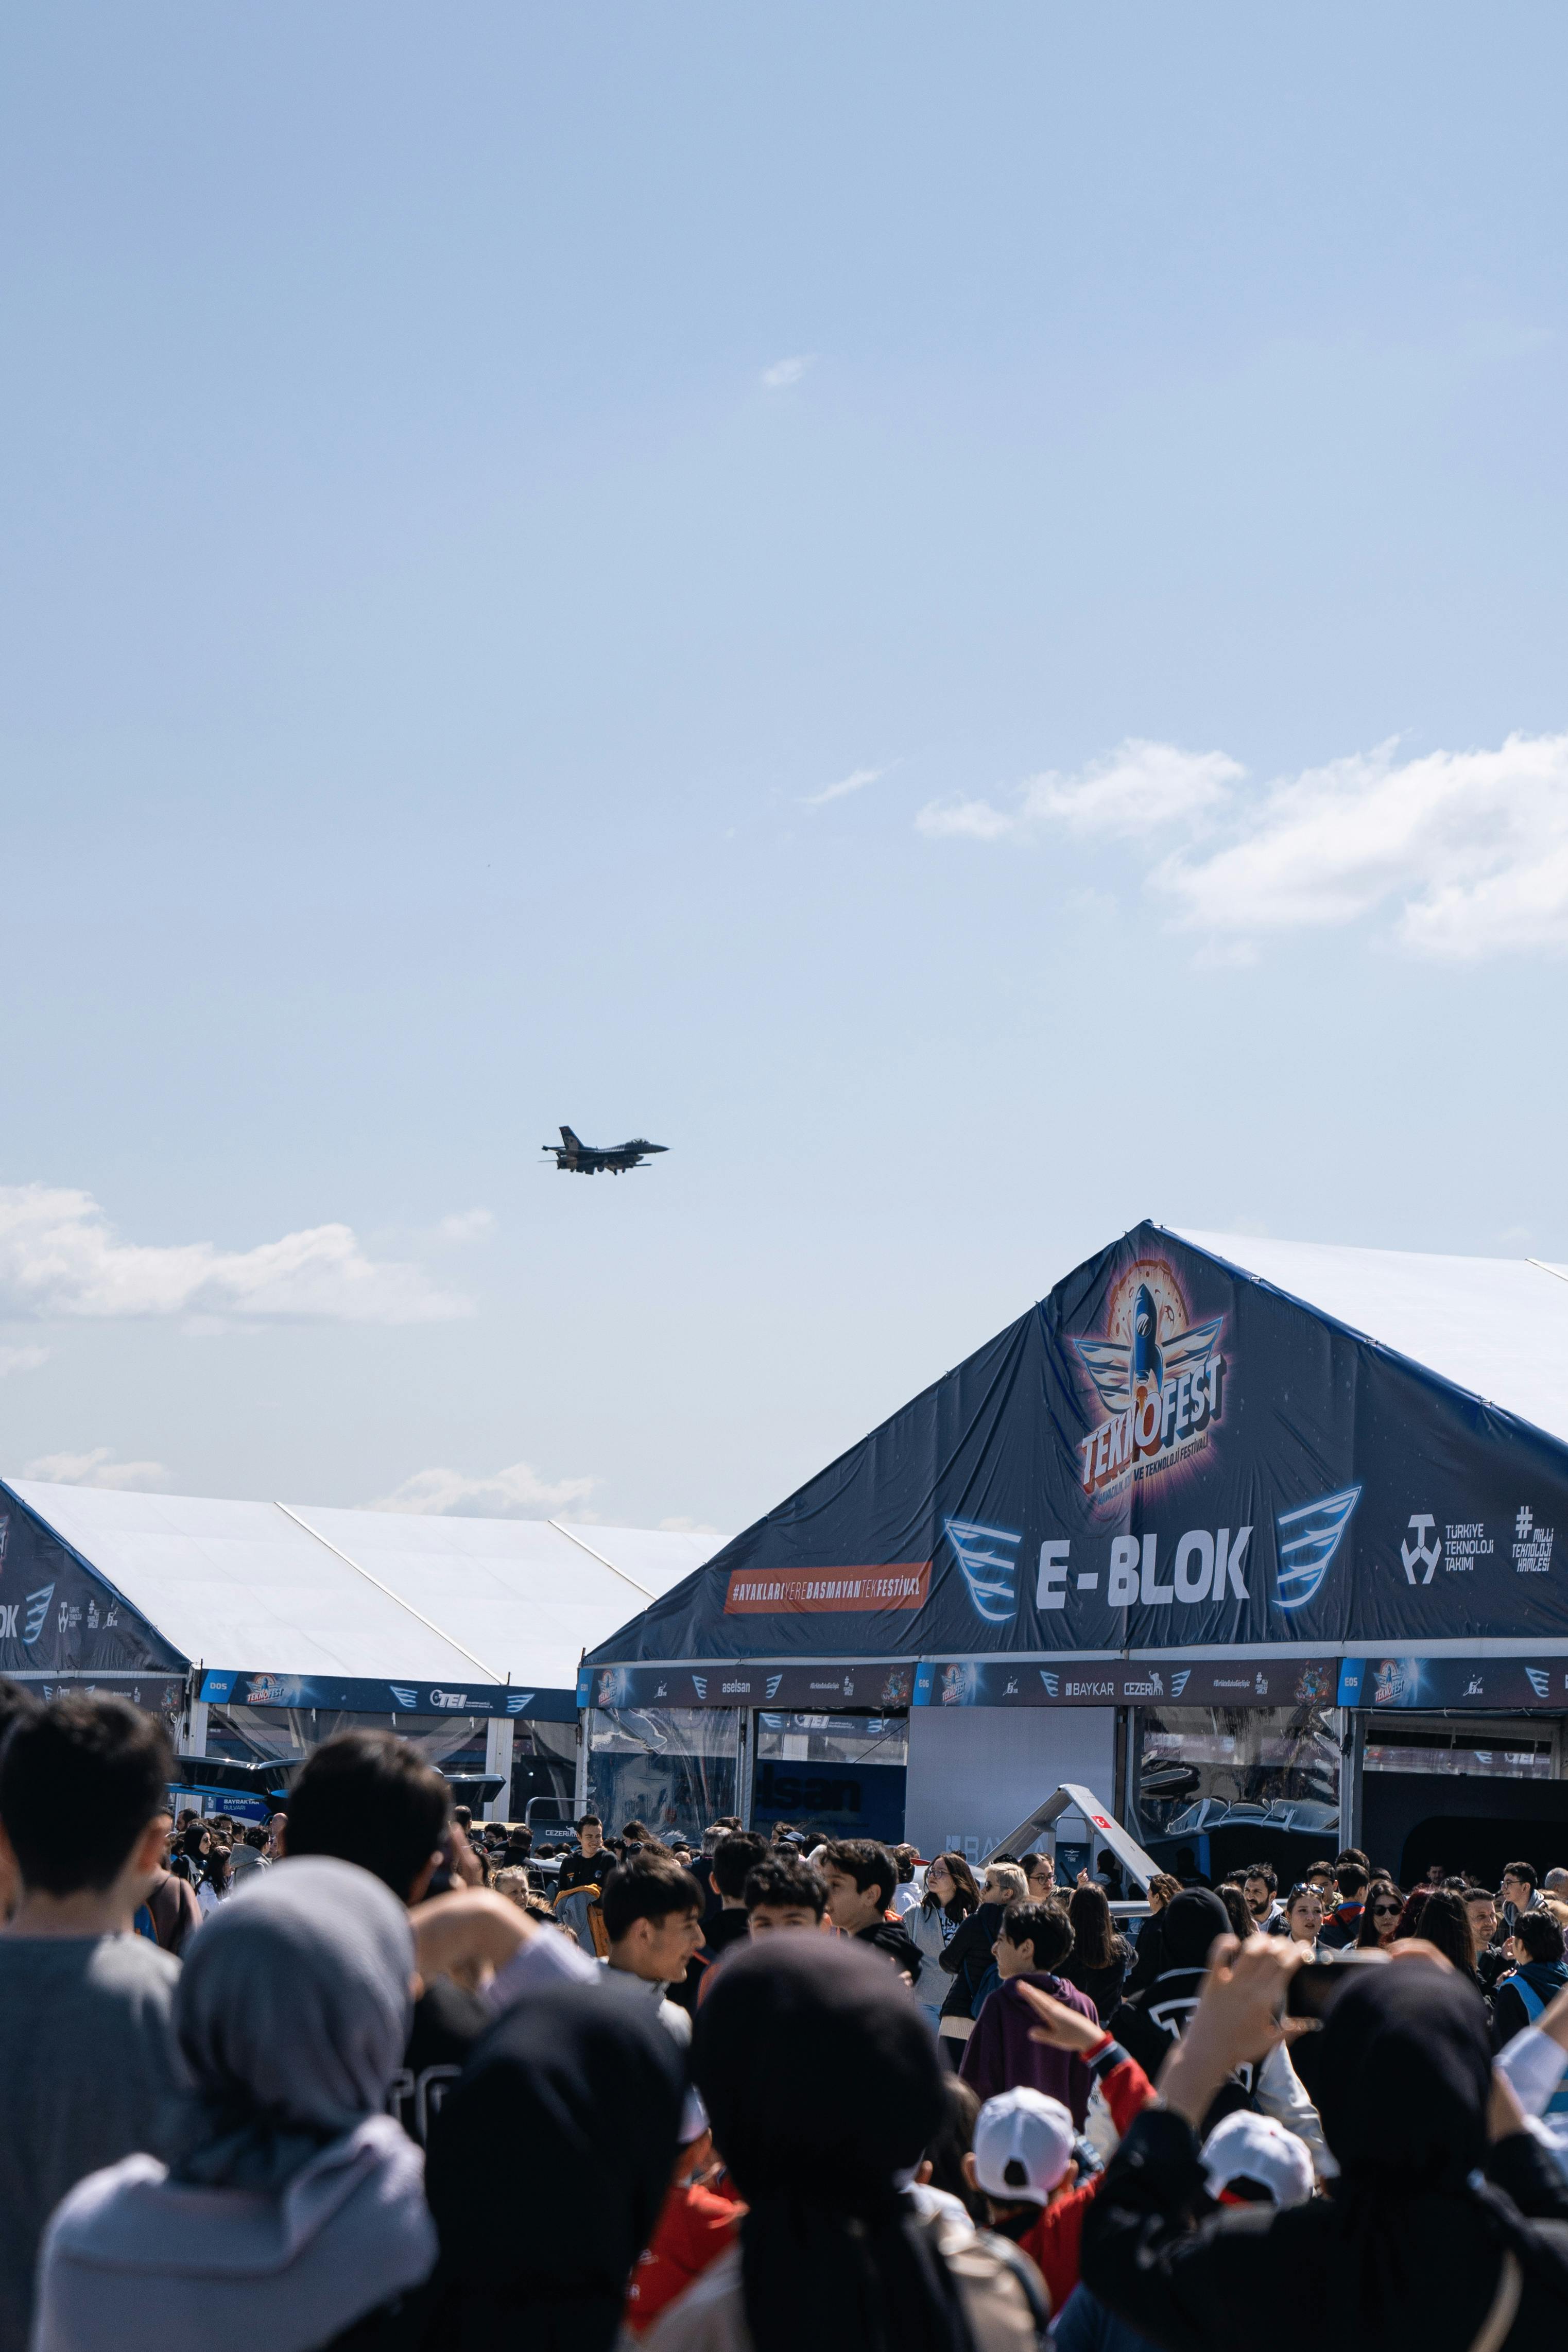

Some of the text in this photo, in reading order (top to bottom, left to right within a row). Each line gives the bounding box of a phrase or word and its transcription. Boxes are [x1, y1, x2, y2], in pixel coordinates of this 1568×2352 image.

[1082, 1353, 1225, 1488] TEKNOFEST
[1134, 1468, 1145, 1481] VE
[1145, 1447, 1180, 1478] TEKNOLOJİ
[1445, 1557, 1474, 1571] TAKIMI
[722, 1679, 750, 1693] aselsan
[1073, 1682, 1114, 1695] BAYKAR
[1375, 1679, 1404, 1703] TEKNOFEST
[247, 1688, 284, 1703] TEKNOFEST
